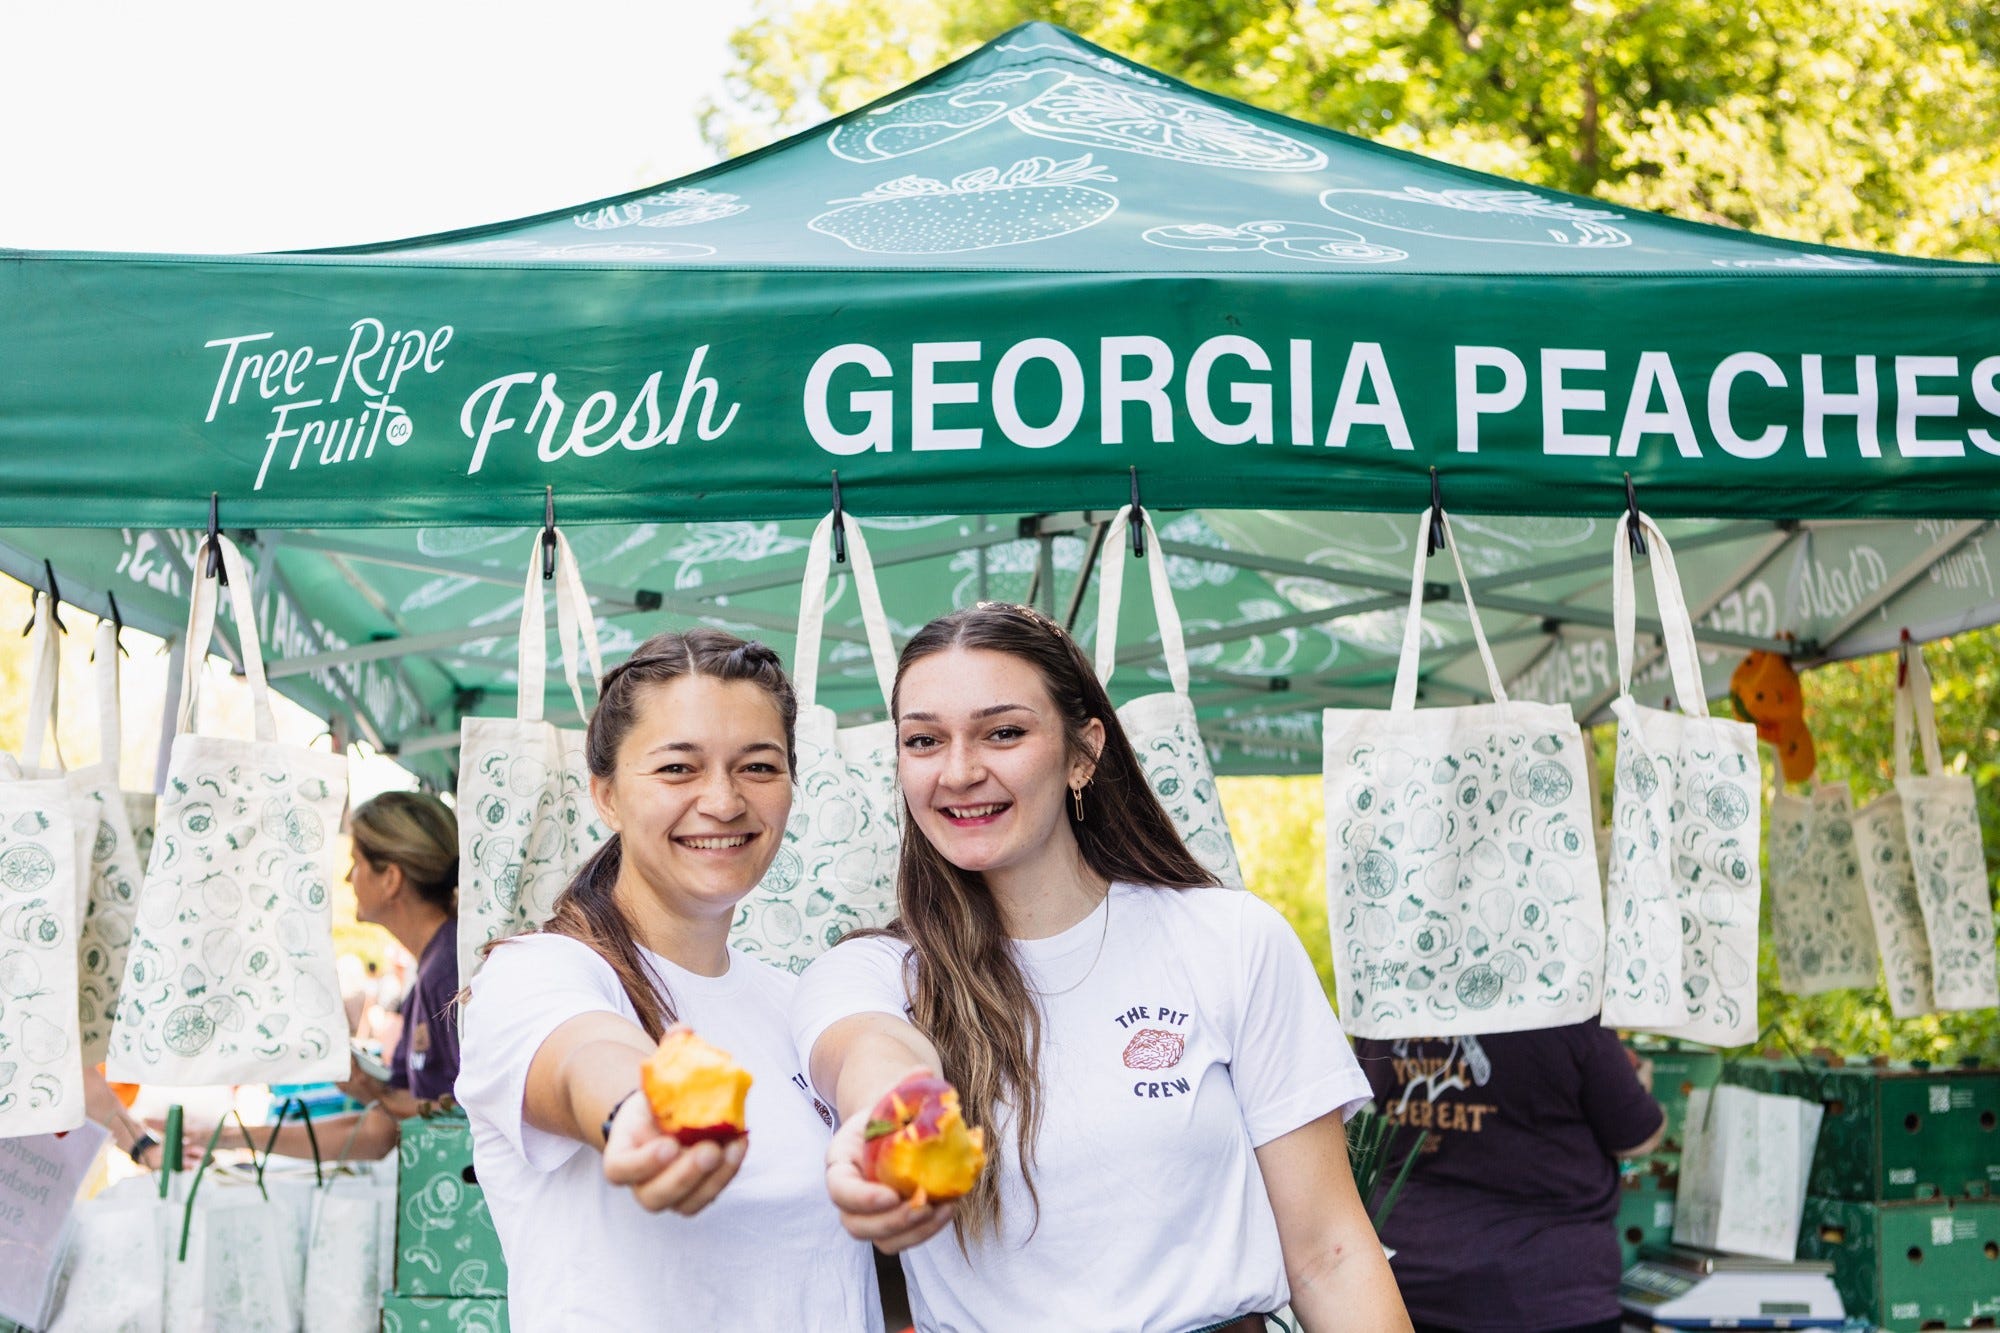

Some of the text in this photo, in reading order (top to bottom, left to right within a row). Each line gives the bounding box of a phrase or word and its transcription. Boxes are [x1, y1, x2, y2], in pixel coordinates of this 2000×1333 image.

[205, 318, 453, 423] Tree-Ripe
[461, 345, 741, 474] Fresh
[803, 335, 1414, 455] GEORGIA
[254, 395, 405, 491] Fruit
[1115, 1006, 1189, 1029] THE PIT
[1134, 1077, 1190, 1098] CREW
